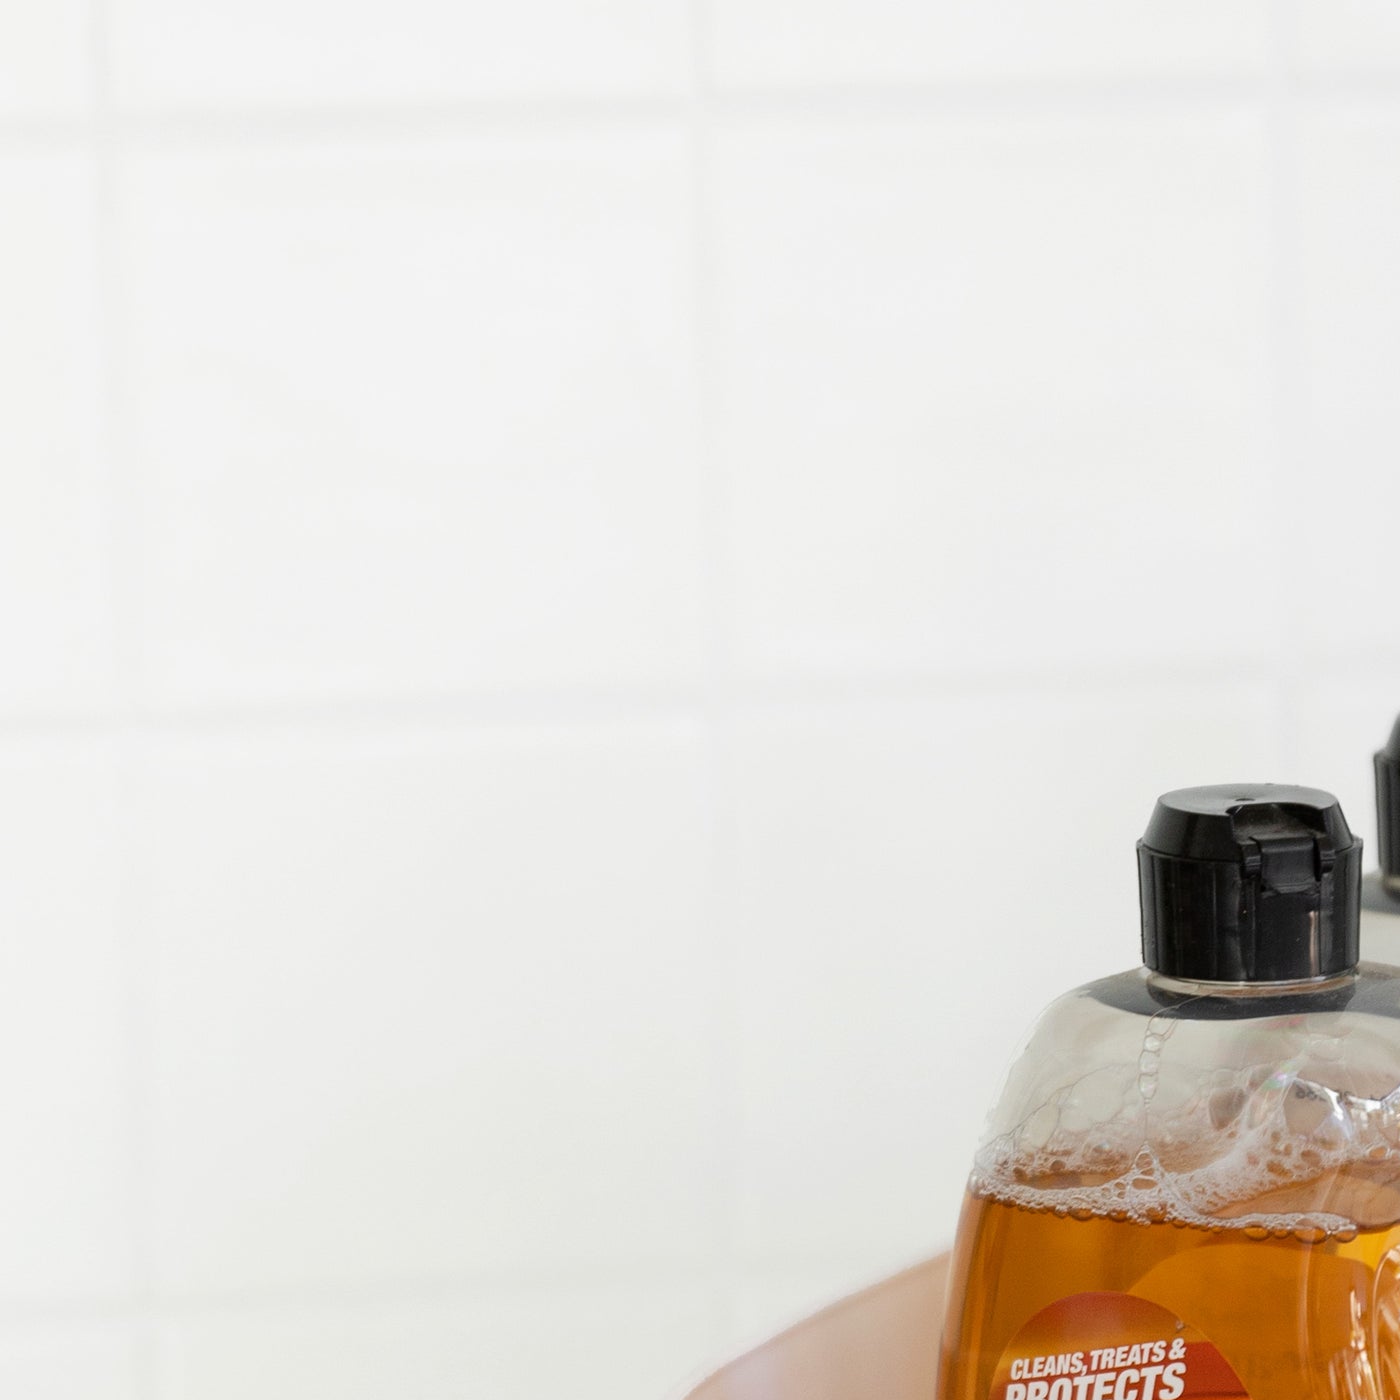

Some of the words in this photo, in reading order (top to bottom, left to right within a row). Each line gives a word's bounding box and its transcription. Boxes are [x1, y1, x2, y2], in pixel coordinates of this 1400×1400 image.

[1010, 1351, 1088, 1381] CLEANS,
[1090, 1340, 1167, 1371] TREATS
[1168, 1337, 1187, 1361] &
